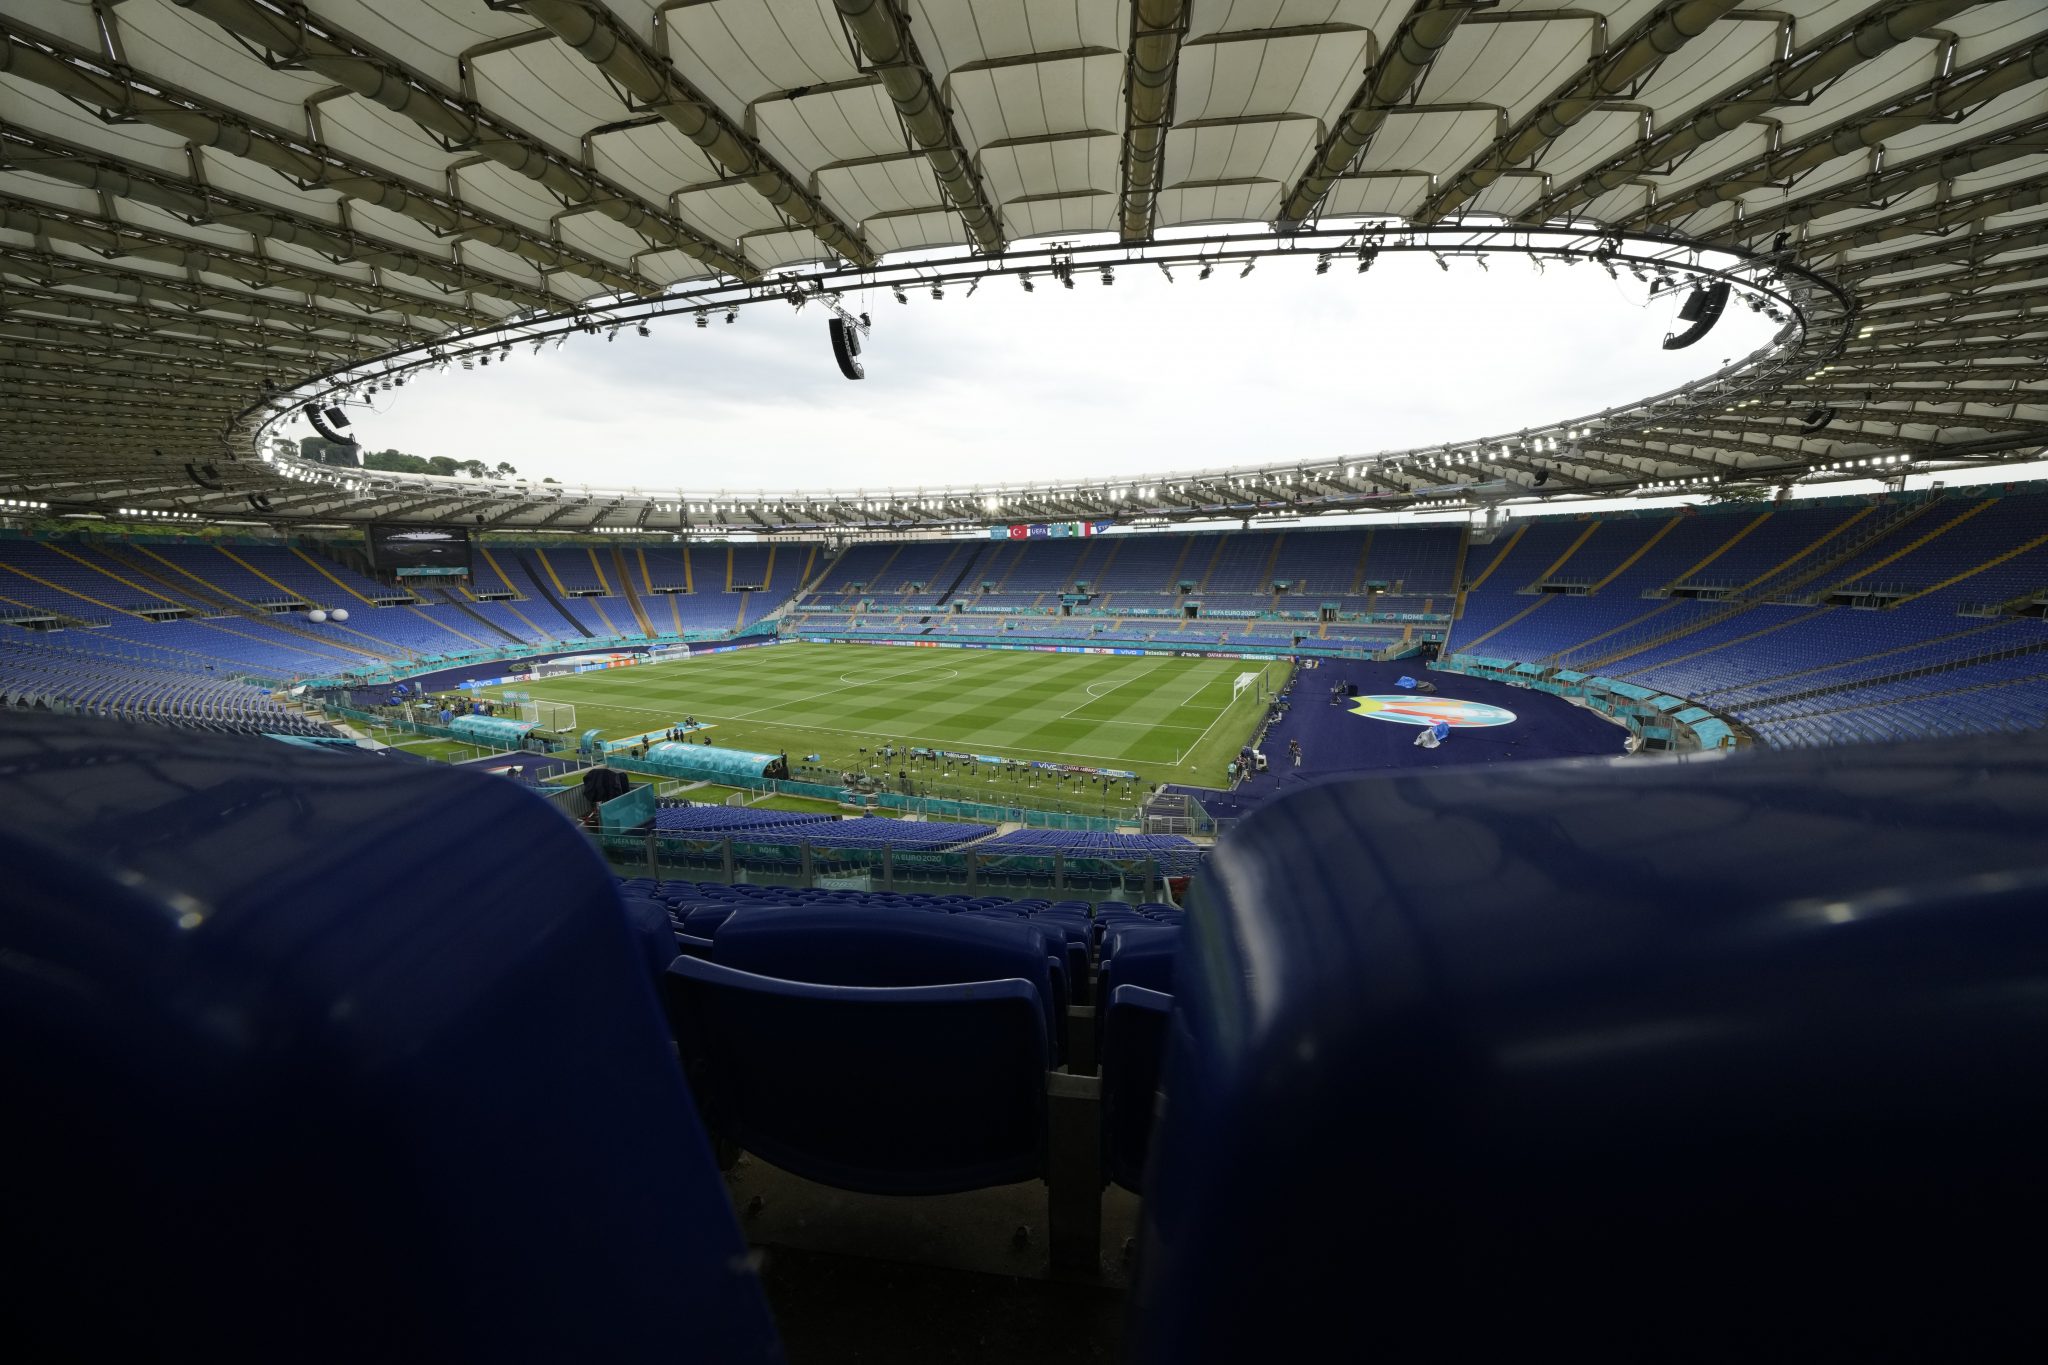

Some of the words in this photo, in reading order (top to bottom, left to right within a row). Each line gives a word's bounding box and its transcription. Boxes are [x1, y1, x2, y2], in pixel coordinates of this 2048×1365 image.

[1243, 653, 1274, 661] Hisense
[470, 680, 493, 689] vivo
[758, 846, 780, 854] ROME
[922, 855, 942, 863] 2020
